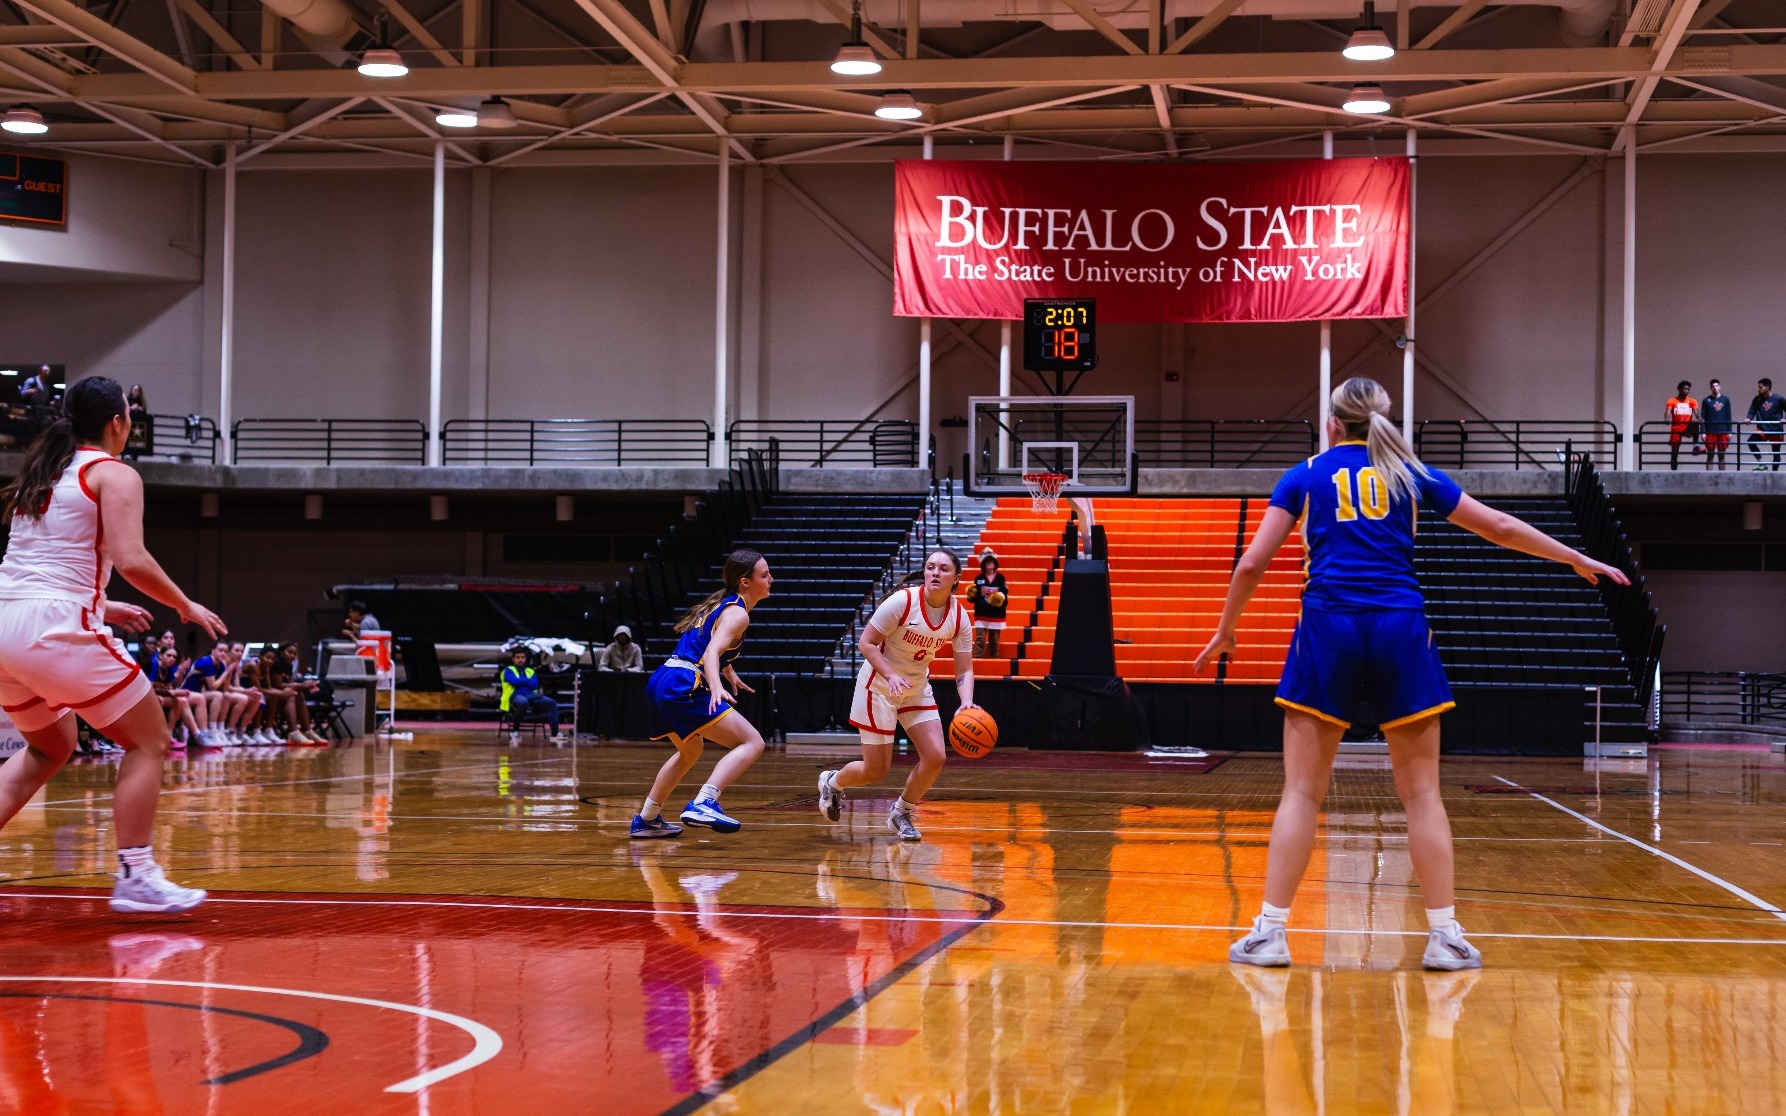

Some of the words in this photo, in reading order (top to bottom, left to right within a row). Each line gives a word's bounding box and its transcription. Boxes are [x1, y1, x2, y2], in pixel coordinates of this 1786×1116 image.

[24, 180, 61, 193] GUEST
[935, 195, 1175, 252] BUFFALO
[1196, 197, 1365, 251] STATE
[937, 254, 988, 280] The
[994, 256, 1055, 281] State
[1063, 258, 1192, 290] University
[1199, 257, 1228, 282] of
[1232, 257, 1292, 282] New
[1299, 253, 1362, 280] York
[1045, 307, 1087, 326] 2:07
[1054, 327, 1079, 360] 18
[1331, 466, 1390, 523] 10
[903, 629, 933, 648] BUFFALO
[934, 638, 947, 648] STA
